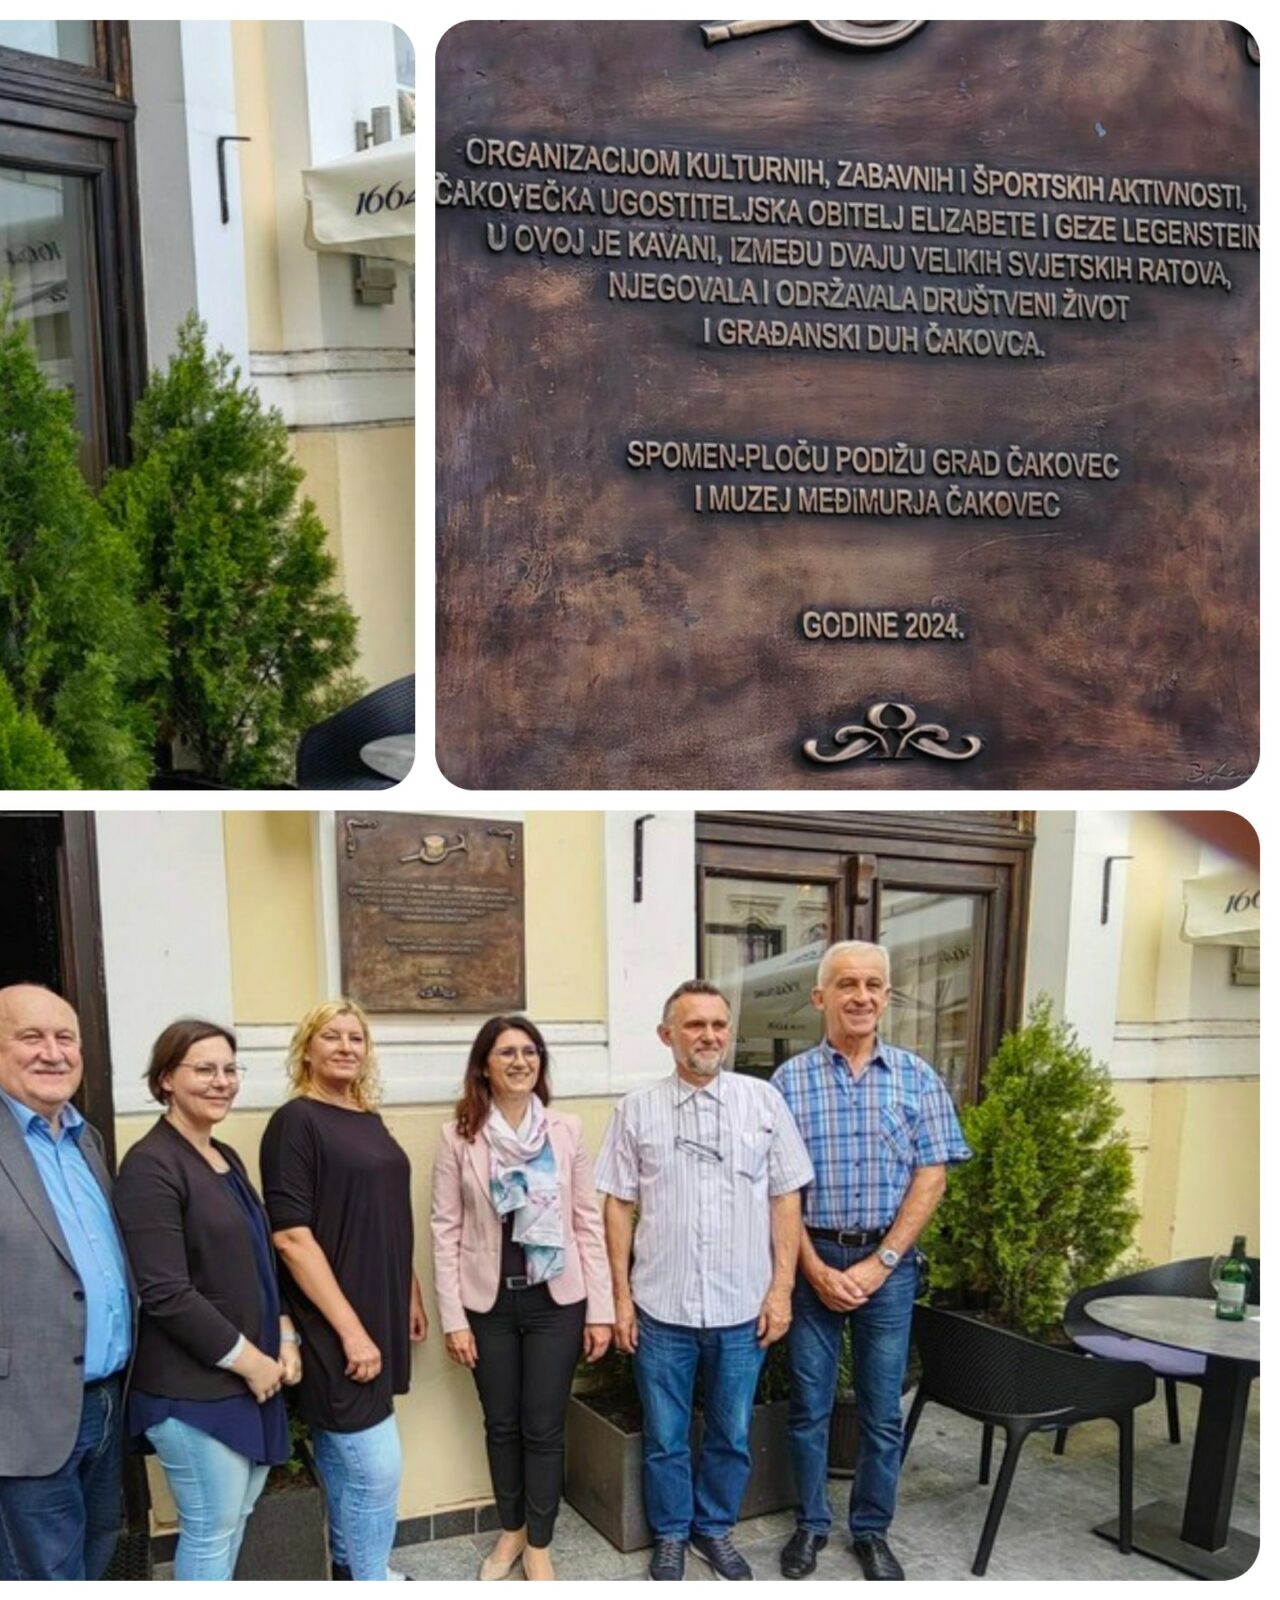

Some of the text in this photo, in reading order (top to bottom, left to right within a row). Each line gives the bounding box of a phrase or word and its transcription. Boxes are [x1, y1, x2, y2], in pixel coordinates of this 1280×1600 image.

[466, 138, 1247, 214] ORGANIZACIJOM KULTURNIH, ZABAVNIH I ŠPORTSKIH AKTIVNOSTI,
[435, 172, 1260, 249] ČAKOVEČKA UGOSTITELJSKA OBITELJ ELIZABETE I GEZE LEGENSTEIN
[487, 222, 1232, 290] U OVOJ JE KAVANI, IZMEĐU DVAJU VELIKIH SVJETSKIH RATOVA,
[608, 271, 1130, 321] NJEGOVALA I ODRŽAVALA DRUŠTVENI ŽIVOT
[703, 317, 1046, 357] I GRAĐANSKI DUH ČAKOVCA.
[627, 440, 1120, 479] SPOMEN-PLOČU PODIŽU GRAD ČAKOVEC
[695, 485, 702, 511] I
[709, 485, 792, 513] MUZEJ
[946, 484, 1061, 517] ČAKOVEC
[803, 611, 965, 639] GODINE 2024.
